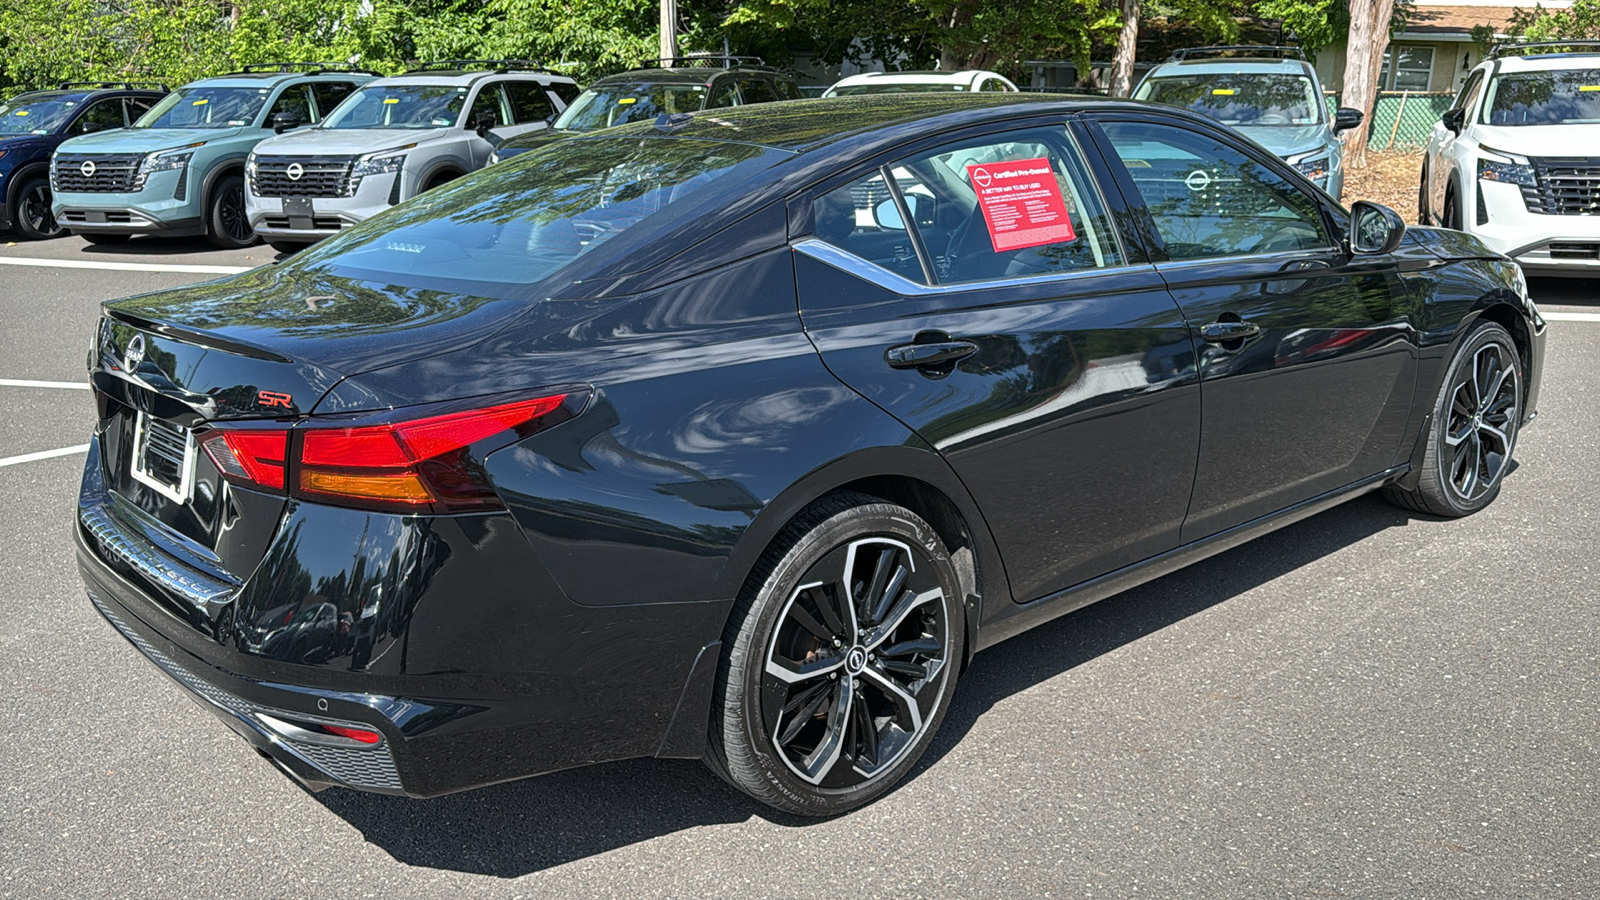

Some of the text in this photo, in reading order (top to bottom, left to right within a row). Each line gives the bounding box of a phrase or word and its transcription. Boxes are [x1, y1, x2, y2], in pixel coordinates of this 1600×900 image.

[993, 167, 1050, 179] Certified Pre-Owned
[125, 348, 145, 362] SSAN
[258, 391, 291, 408] SR
[766, 770, 809, 804] TURANZA
